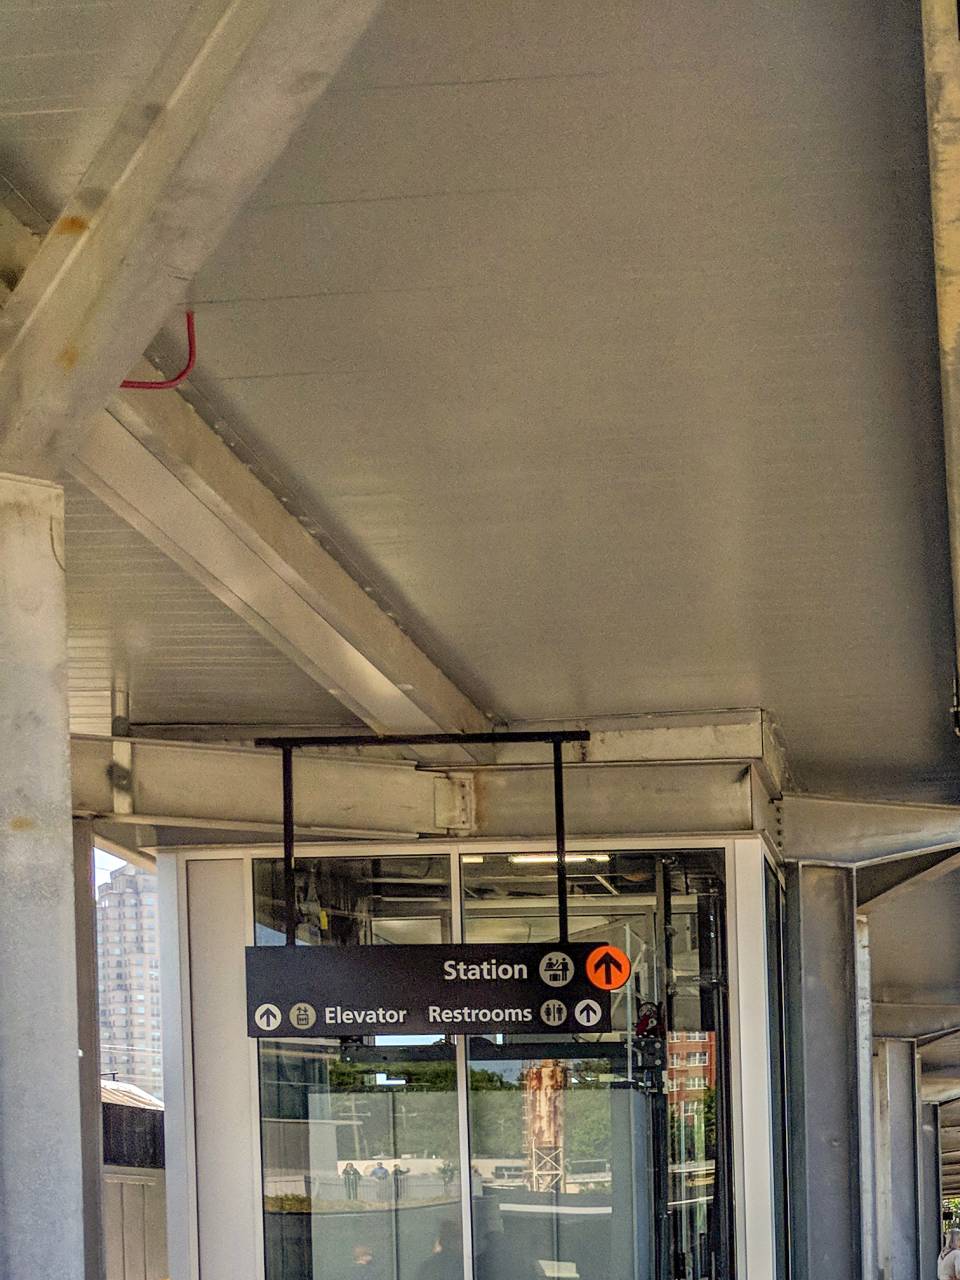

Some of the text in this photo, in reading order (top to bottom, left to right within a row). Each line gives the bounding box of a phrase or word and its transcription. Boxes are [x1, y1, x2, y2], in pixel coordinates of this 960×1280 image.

[443, 960, 528, 981] Station
[324, 1006, 407, 1024] Elevator
[428, 1005, 533, 1023] Restrooms
